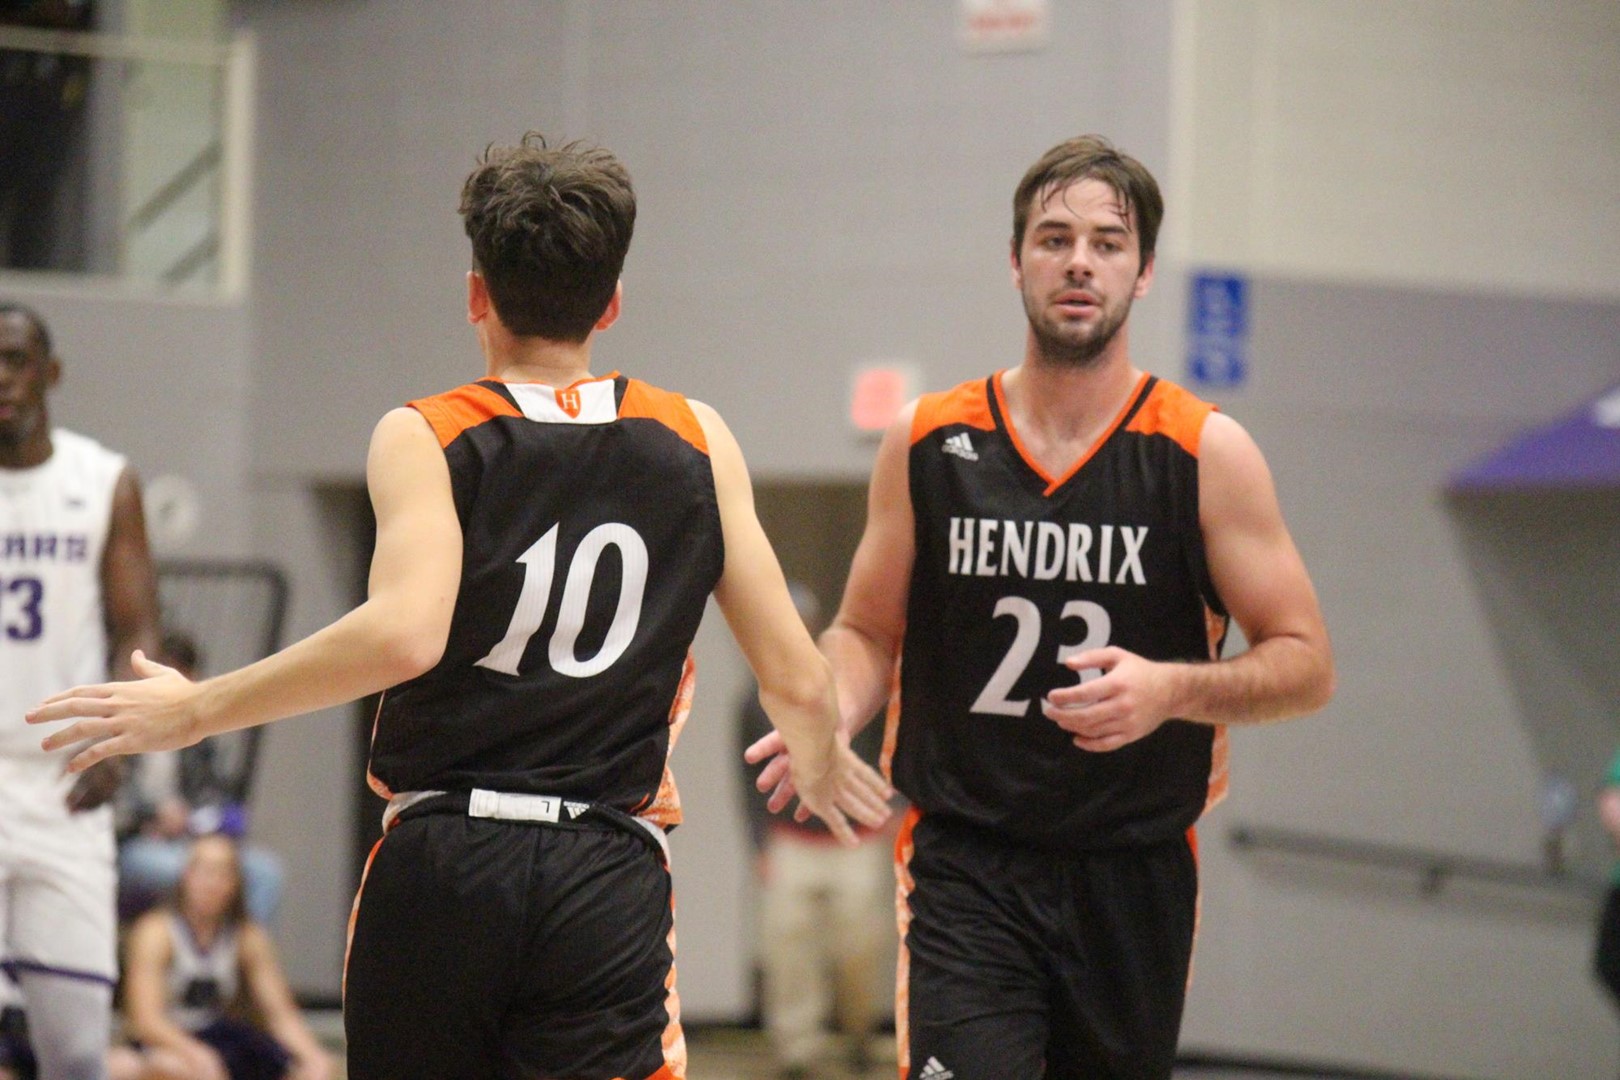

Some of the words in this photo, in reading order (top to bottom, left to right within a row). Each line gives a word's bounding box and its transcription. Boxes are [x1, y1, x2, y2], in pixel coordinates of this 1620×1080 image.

[561, 392, 579, 410] H
[0, 534, 88, 562] ARS
[948, 516, 1149, 586] HENDRIX
[472, 520, 649, 678] 10
[969, 595, 1112, 717] 23
